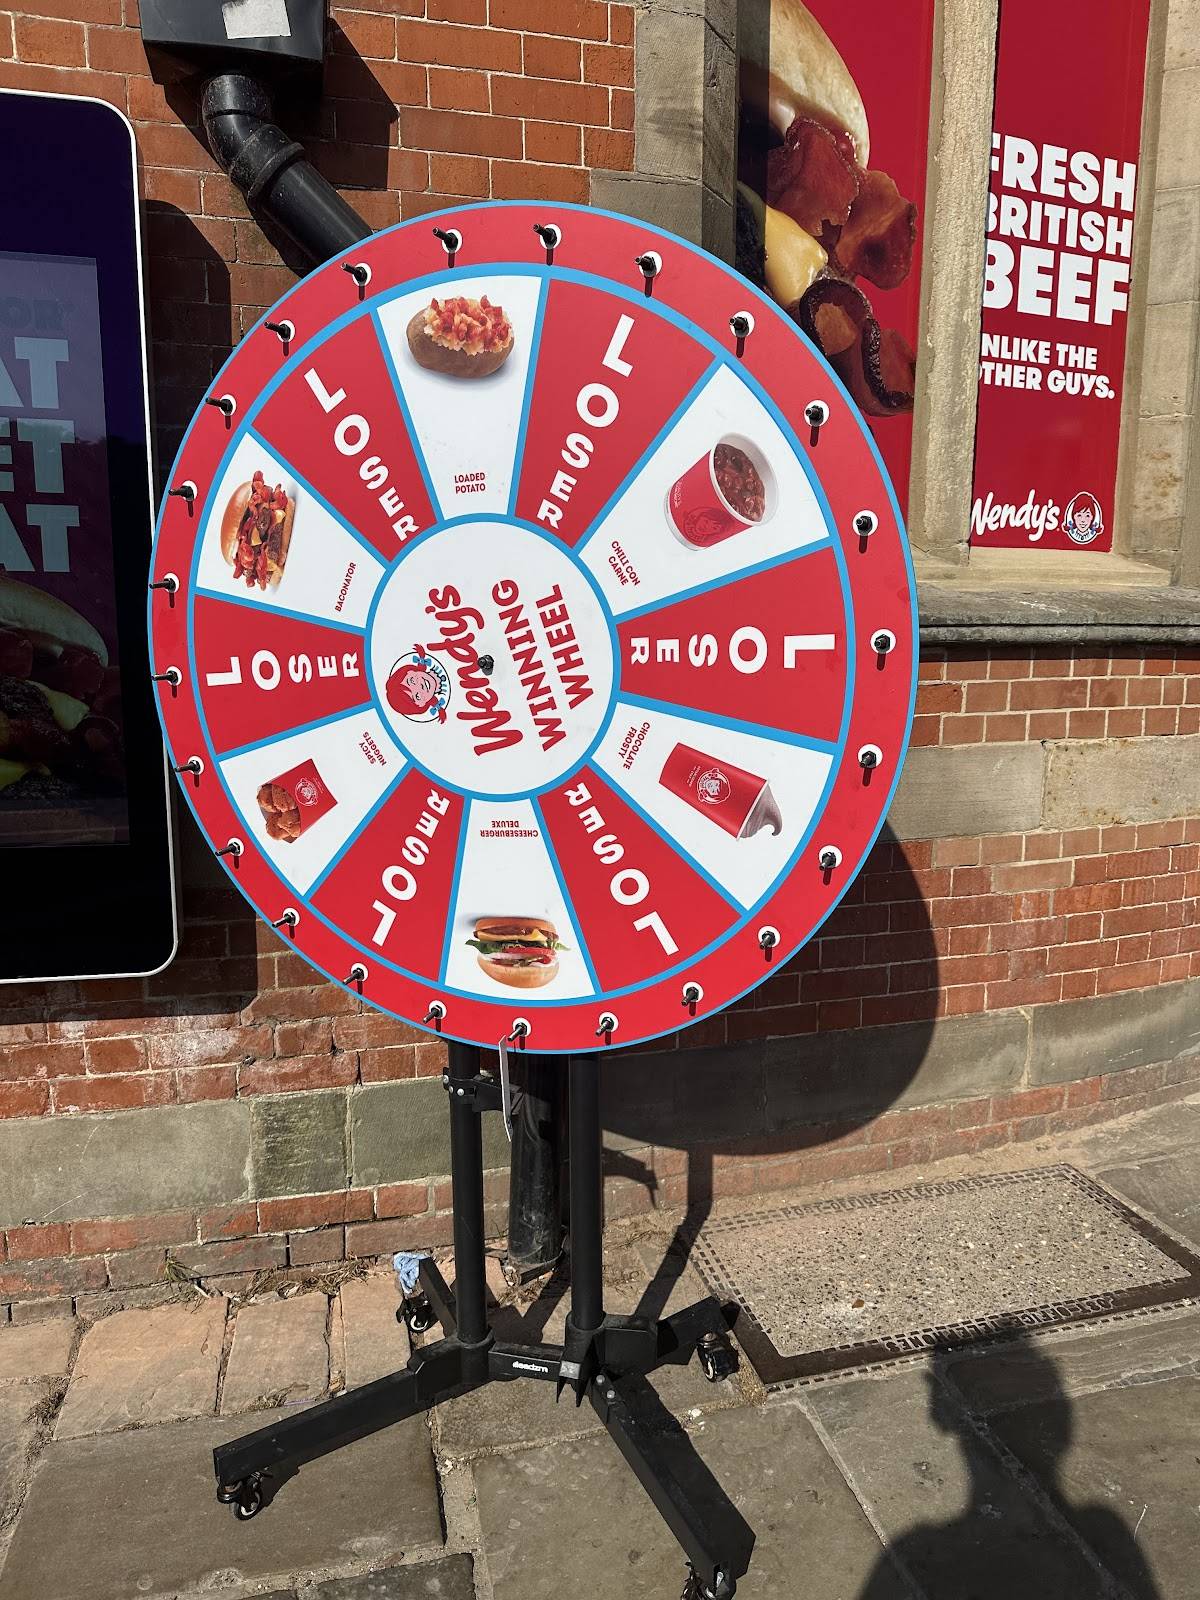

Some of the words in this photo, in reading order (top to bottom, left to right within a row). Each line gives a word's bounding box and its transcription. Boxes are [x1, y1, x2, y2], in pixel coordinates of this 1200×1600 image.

[983, 239, 1131, 326] BEEF
[0, 336, 70, 409] T
[981, 333, 1052, 364] NLIKE
[1056, 343, 1098, 370] THE
[979, 361, 1043, 391] THER
[1047, 369, 1115, 399] GUYS.
[537, 314, 634, 528] LOSER
[305, 368, 419, 541] LOSER
[454, 472, 486, 483] LOADED
[455, 483, 486, 494] POTATO
[608, 556, 629, 586] CARNE
[611, 541, 630, 567] CHILI
[625, 565, 641, 586] CON
[335, 562, 357, 612] BACONATOR
[206, 650, 360, 690] LOSER
[491, 579, 567, 752] WINNING
[535, 584, 594, 710] WHEEL
[631, 626, 836, 673] LOSER
[425, 585, 524, 757] Wendy's
[358, 741, 377, 765] SPICY
[362, 731, 387, 766] NUGGETS
[618, 726, 637, 759] FROSTY
[623, 722, 650, 770] CHOCOLATE
[480, 829, 539, 838] CHEESEBURGER
[491, 820, 520, 828] DELUXE
[372, 789, 449, 946] LOSER
[565, 783, 678, 955] LOSER
